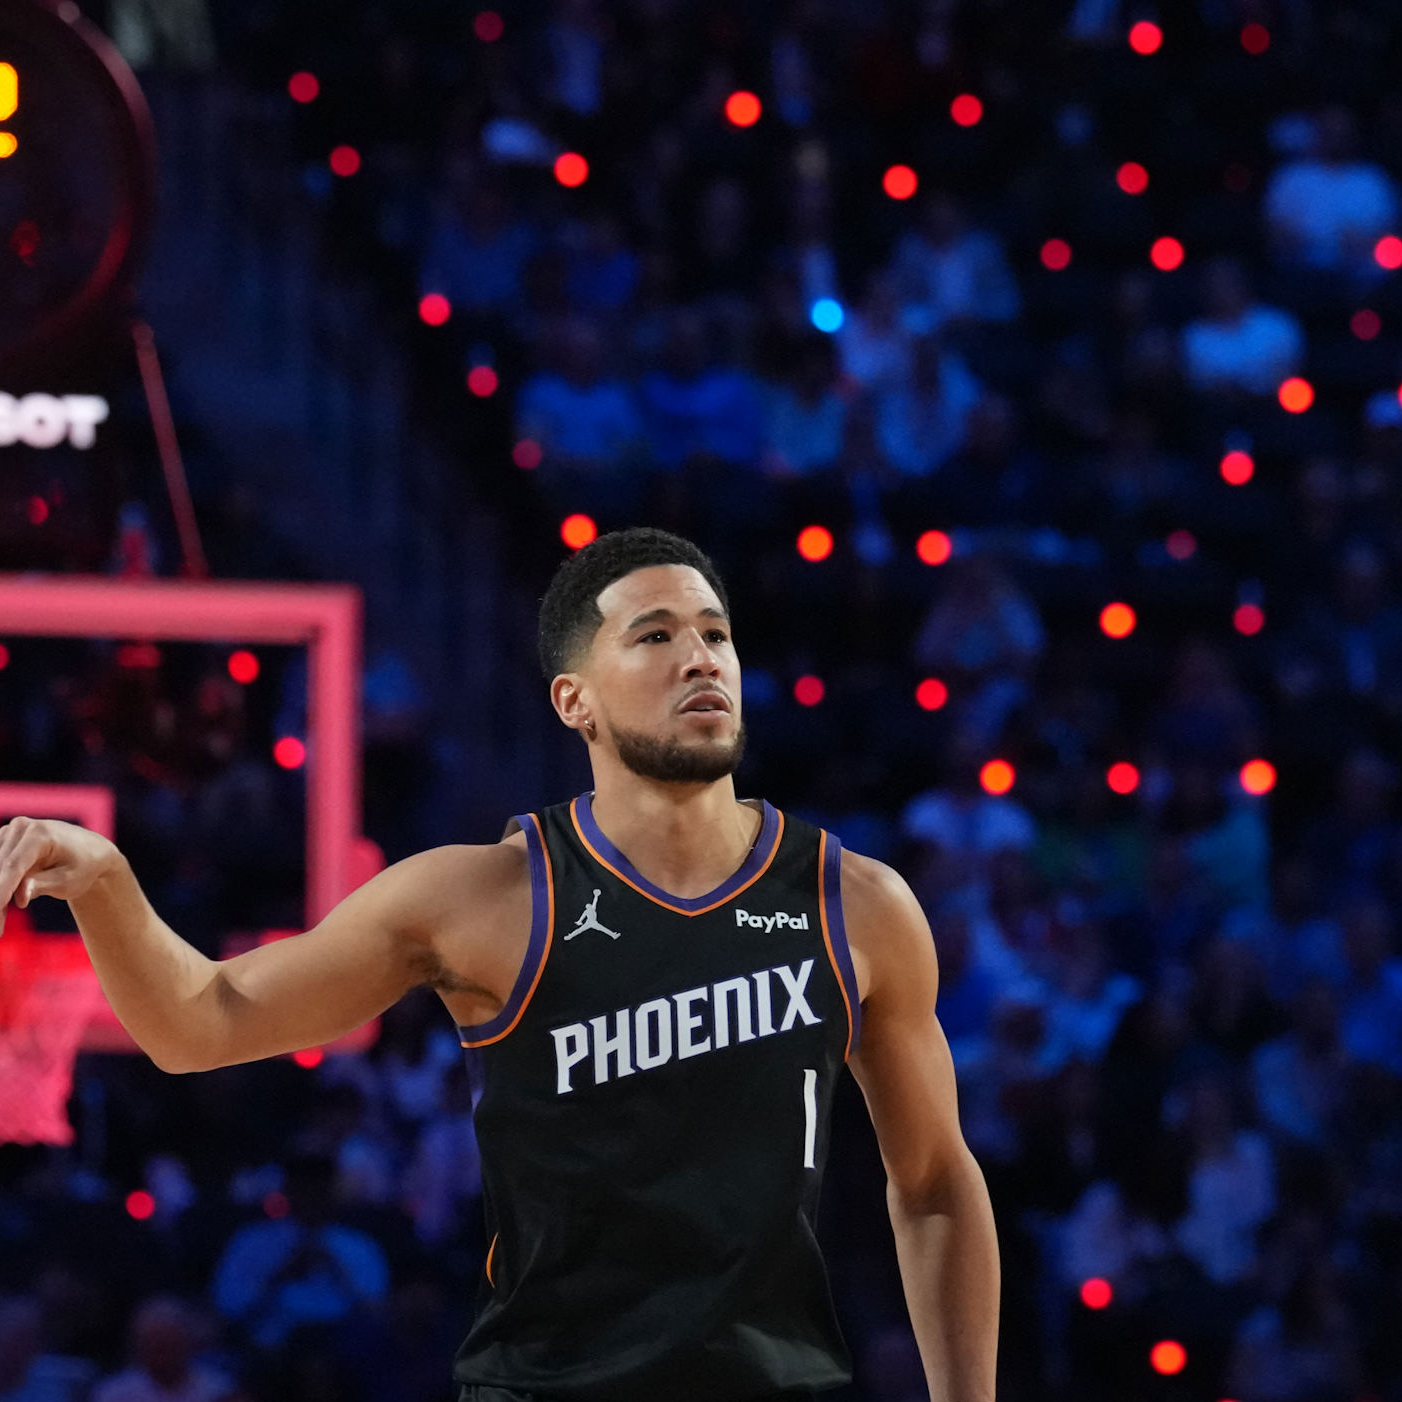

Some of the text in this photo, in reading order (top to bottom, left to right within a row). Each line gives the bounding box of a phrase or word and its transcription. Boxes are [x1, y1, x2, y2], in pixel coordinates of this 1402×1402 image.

[735, 909, 809, 934] PayPal
[550, 959, 823, 1095] PHOENIX
[804, 1069, 817, 1169] 1
